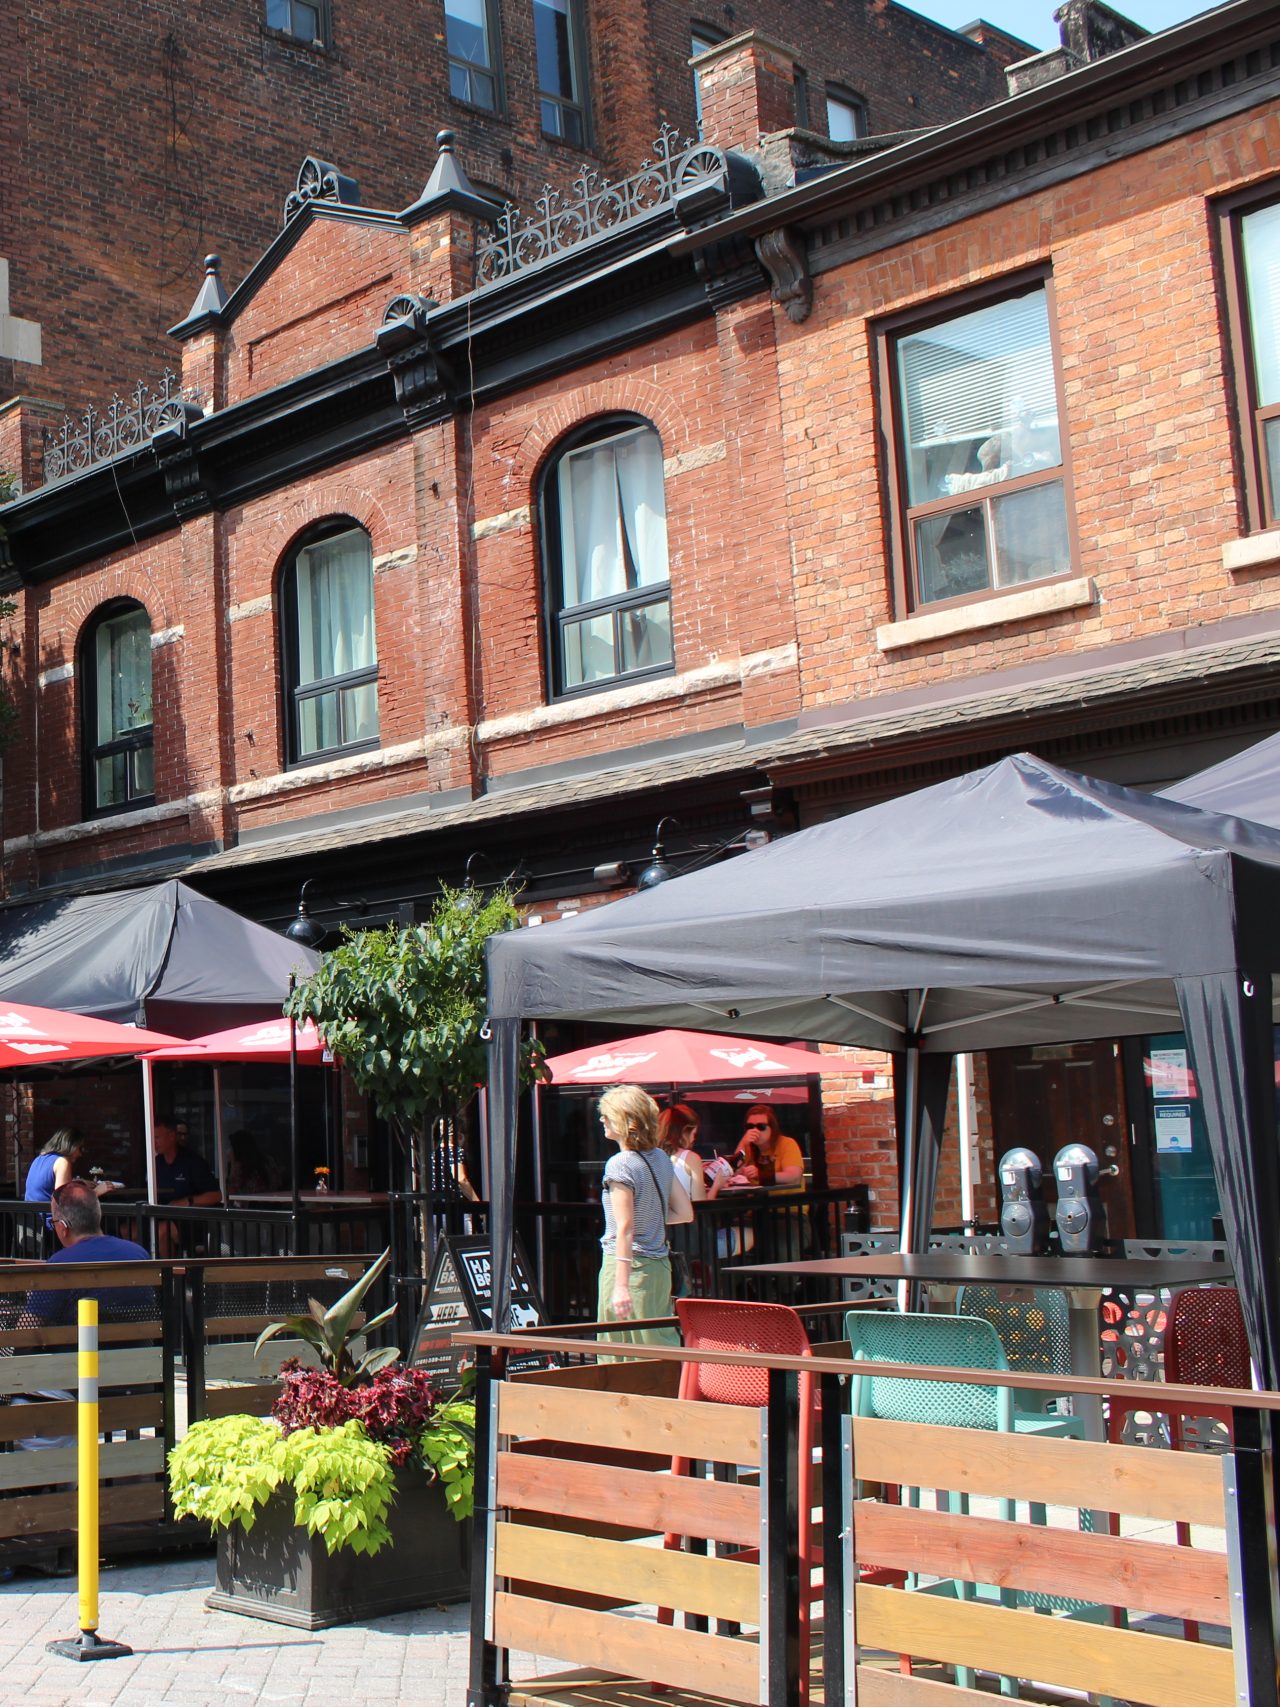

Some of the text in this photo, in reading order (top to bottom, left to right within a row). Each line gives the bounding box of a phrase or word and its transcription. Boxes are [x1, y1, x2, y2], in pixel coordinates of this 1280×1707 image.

[470, 1259, 491, 1274] HA
[441, 1270, 458, 1284] BR
[437, 1305, 460, 1320] HERE
